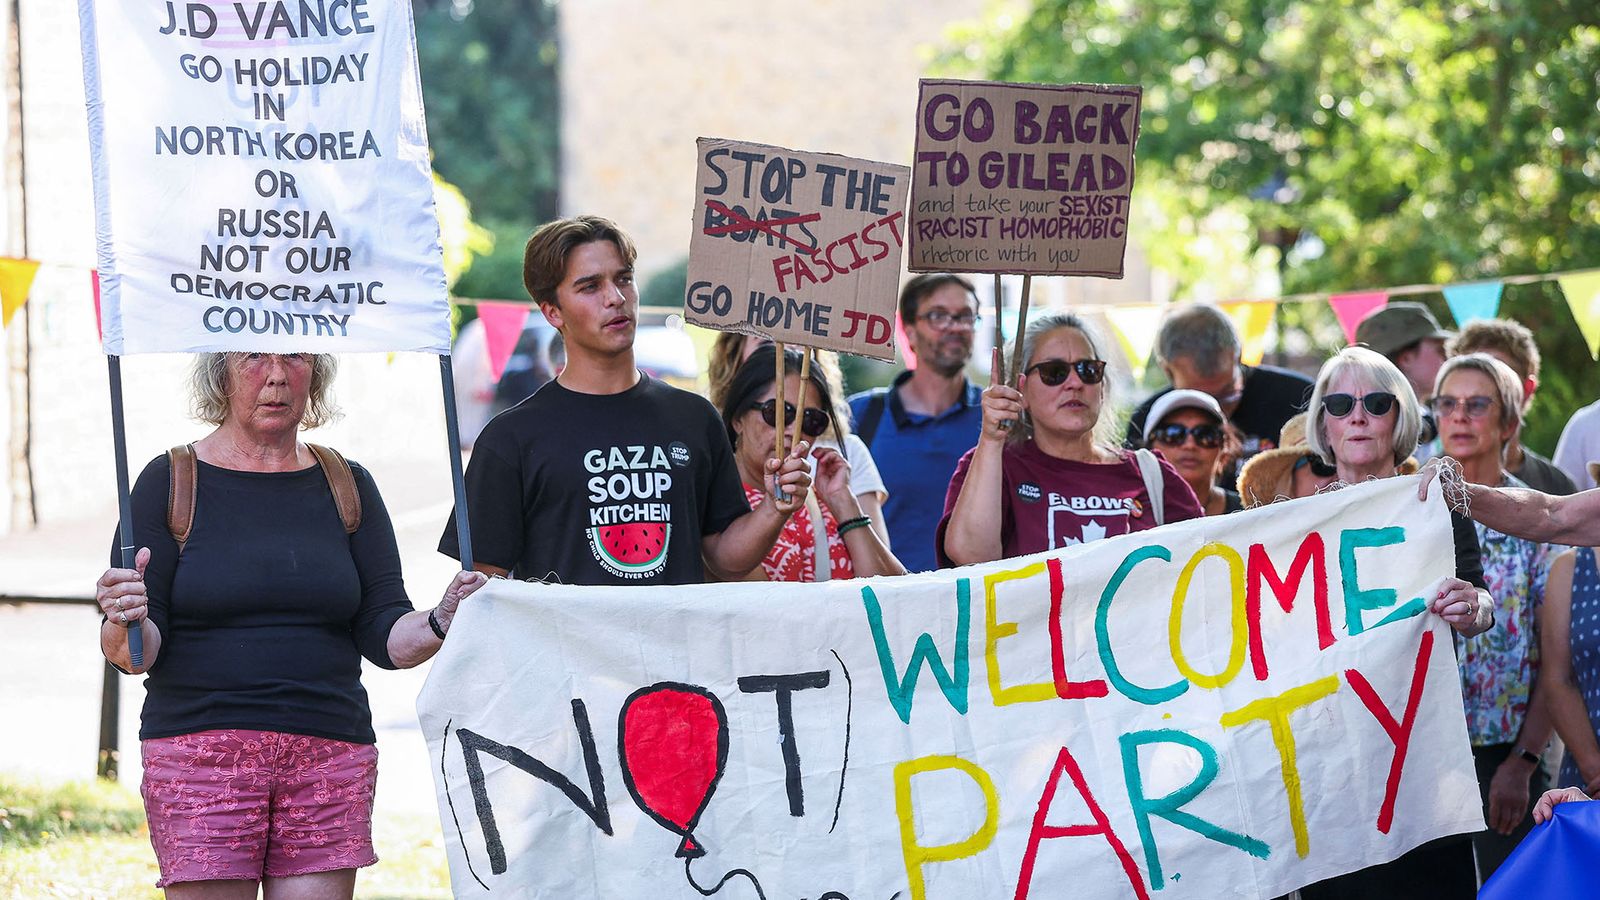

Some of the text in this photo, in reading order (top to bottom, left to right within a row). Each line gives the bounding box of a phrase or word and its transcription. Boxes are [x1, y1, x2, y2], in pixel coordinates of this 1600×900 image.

[159, 0, 376, 41] J.D VANCE
[179, 52, 369, 87] GO HOLIDAY
[254, 92, 286, 121] IN
[924, 93, 1132, 145] GO BACK
[155, 126, 267, 157] NORTH
[274, 129, 382, 161] KOREA
[254, 169, 299, 199] OR
[703, 148, 897, 216] STOP THE
[918, 151, 1128, 191] TO GILEAD
[918, 193, 1130, 219] and take your SEXIST
[217, 208, 337, 239] RUSSIA
[703, 199, 819, 256] BOATS
[916, 215, 1126, 242] RACIST HOMOPHOBIC
[199, 244, 269, 273] NOT
[285, 246, 352, 275] OUR
[771, 211, 903, 293] FASCIST
[921, 243, 1081, 273] rhetoric with you
[170, 273, 387, 305] DEMOCRATIC
[202, 306, 351, 337] COUNTRY
[686, 280, 892, 348] GO HOME JD.
[583, 445, 672, 474] GAZA
[587, 472, 673, 503] SOUP
[1021, 484, 1040, 492] STOP
[589, 503, 671, 525] KITCHEN
[585, 527, 593, 540] NO
[589, 540, 601, 561] CHILD
[599, 560, 624, 578] SHOULD
[861, 526, 1427, 724] WELCOME
[893, 630, 1434, 900] PARTY
